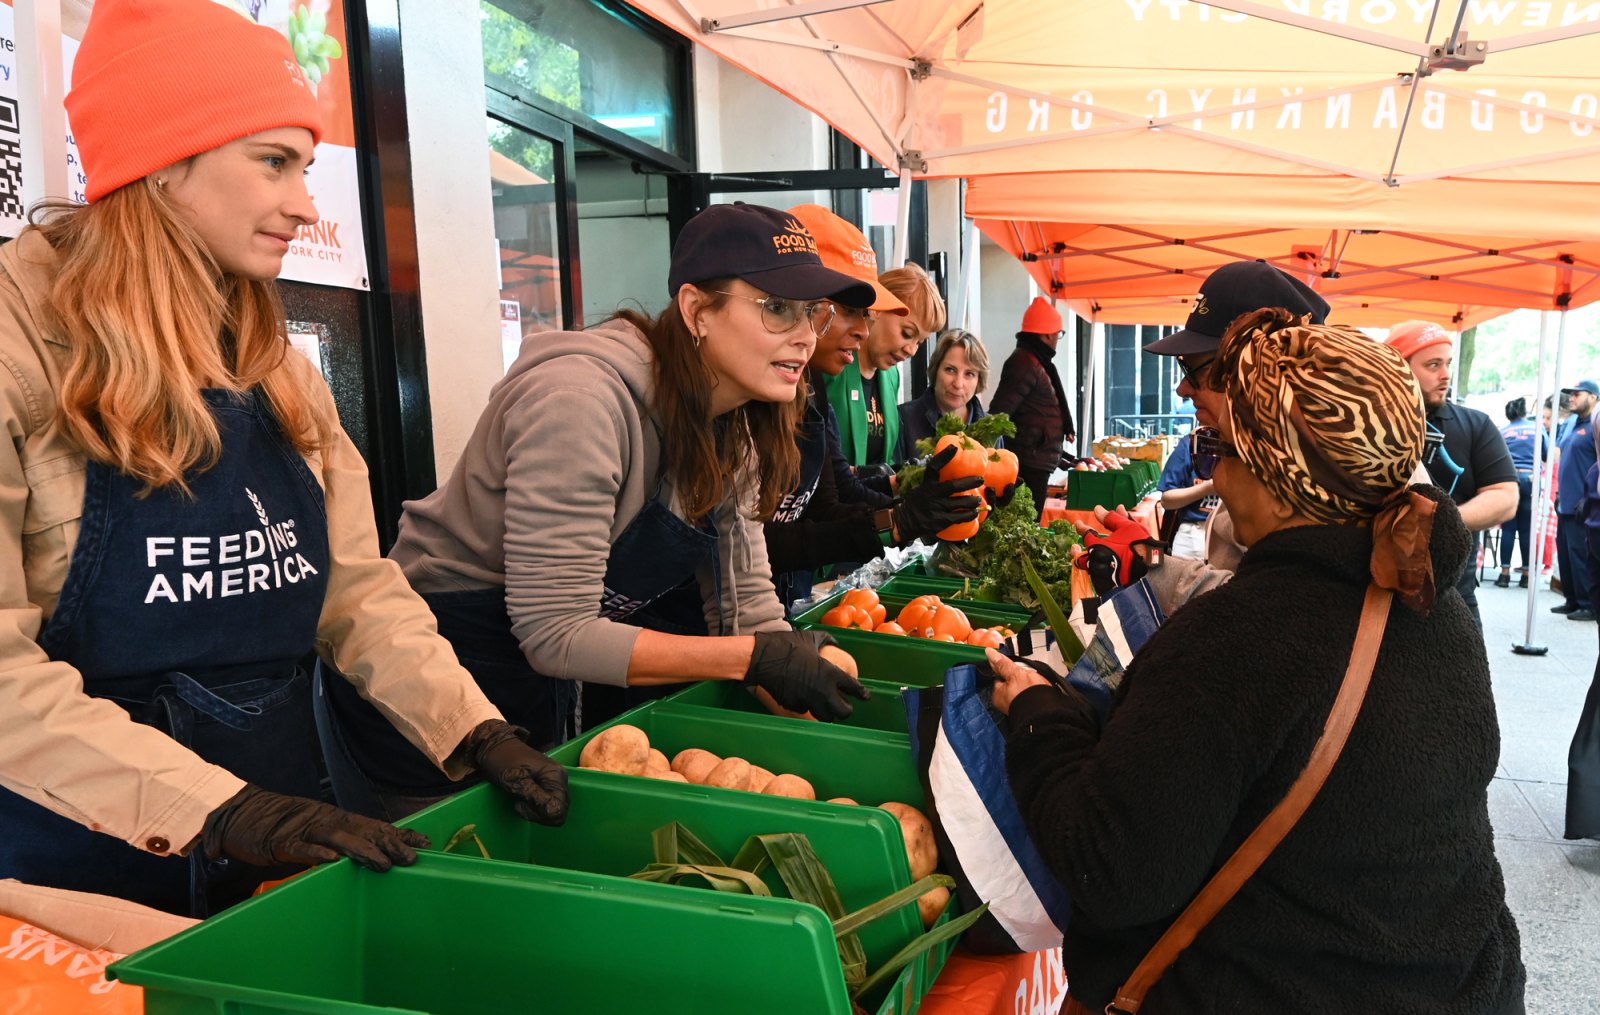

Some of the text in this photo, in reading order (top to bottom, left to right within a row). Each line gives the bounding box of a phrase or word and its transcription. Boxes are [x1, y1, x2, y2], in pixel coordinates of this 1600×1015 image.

[773, 234, 805, 248] FOOD
[318, 249, 343, 263] CITY
[144, 552, 319, 604] AMERICA
